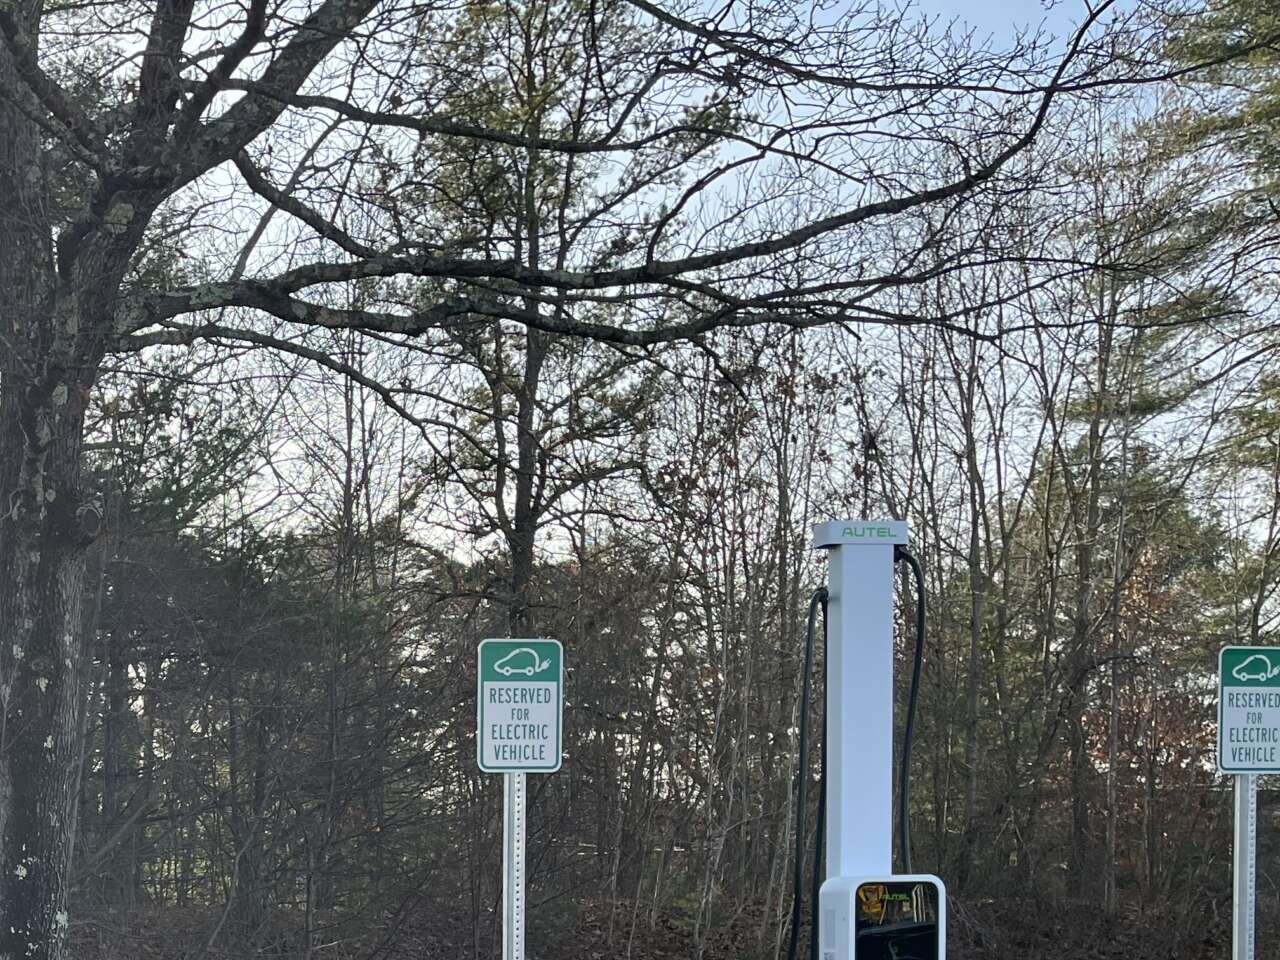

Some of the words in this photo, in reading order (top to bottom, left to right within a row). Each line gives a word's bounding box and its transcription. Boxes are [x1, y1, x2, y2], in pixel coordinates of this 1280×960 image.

[842, 527, 897, 538] AUTEL
[489, 687, 551, 704] RESERVED
[1228, 692, 1280, 708] RESERVED
[511, 708, 530, 721] FOR
[1246, 711, 1262, 724] FOR
[491, 724, 549, 740] ELECTRIC
[1229, 727, 1278, 743] ELECTRIC
[493, 744, 546, 761] VEHICLE
[1231, 746, 1276, 763] VEHICLE
